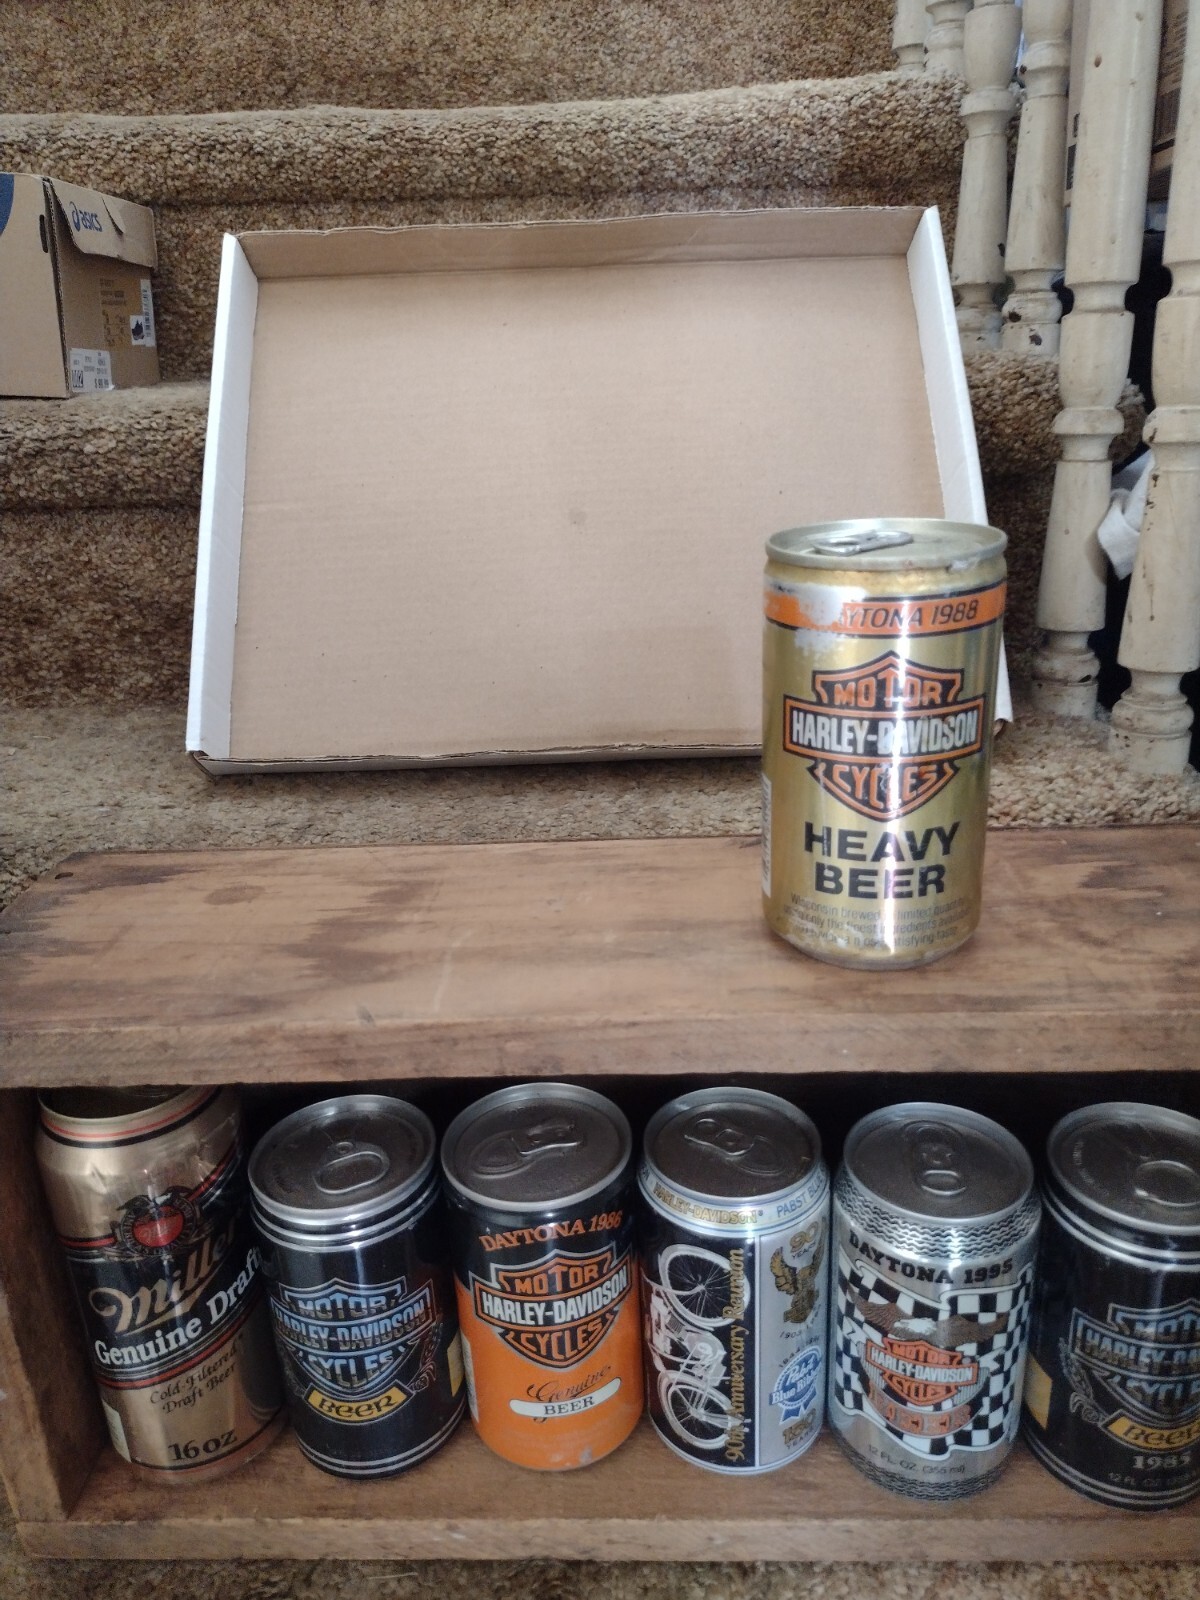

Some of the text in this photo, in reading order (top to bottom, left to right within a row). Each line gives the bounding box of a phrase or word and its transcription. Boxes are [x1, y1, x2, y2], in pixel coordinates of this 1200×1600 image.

[931, 599, 979, 625] 1988
[833, 667, 941, 709] MOTOR
[792, 709, 978, 756] HARLEY-DAVIDSON
[804, 821, 961, 862] HEAVY
[815, 862, 946, 899] BEER
[653, 1182, 758, 1225] HARLEY-DAVIDSON
[776, 1192, 807, 1218] PABST
[478, 1209, 623, 1251] DAYTONA 1986
[849, 1231, 1013, 1284] DAYTONA 1995
[482, 1267, 627, 1325] HARLEY-DAVIDSON
[515, 1264, 599, 1295] MOTOR
[723, 1248, 744, 1321] Reunion
[275, 1298, 427, 1350] HARLEY-DAVIDSON
[298, 1293, 387, 1319] MOTOR
[95, 1314, 202, 1366] Genuine
[521, 1320, 604, 1360] CYCLES
[308, 1351, 394, 1387] CYCLES
[727, 1324, 750, 1420] Anniversary
[871, 1346, 973, 1383] HARLEY-DAVIDSON
[162, 1362, 236, 1414] Draft Beer
[544, 1397, 595, 1416] BEER
[772, 1390, 796, 1405] Blue
[168, 1440, 200, 1461] 16
